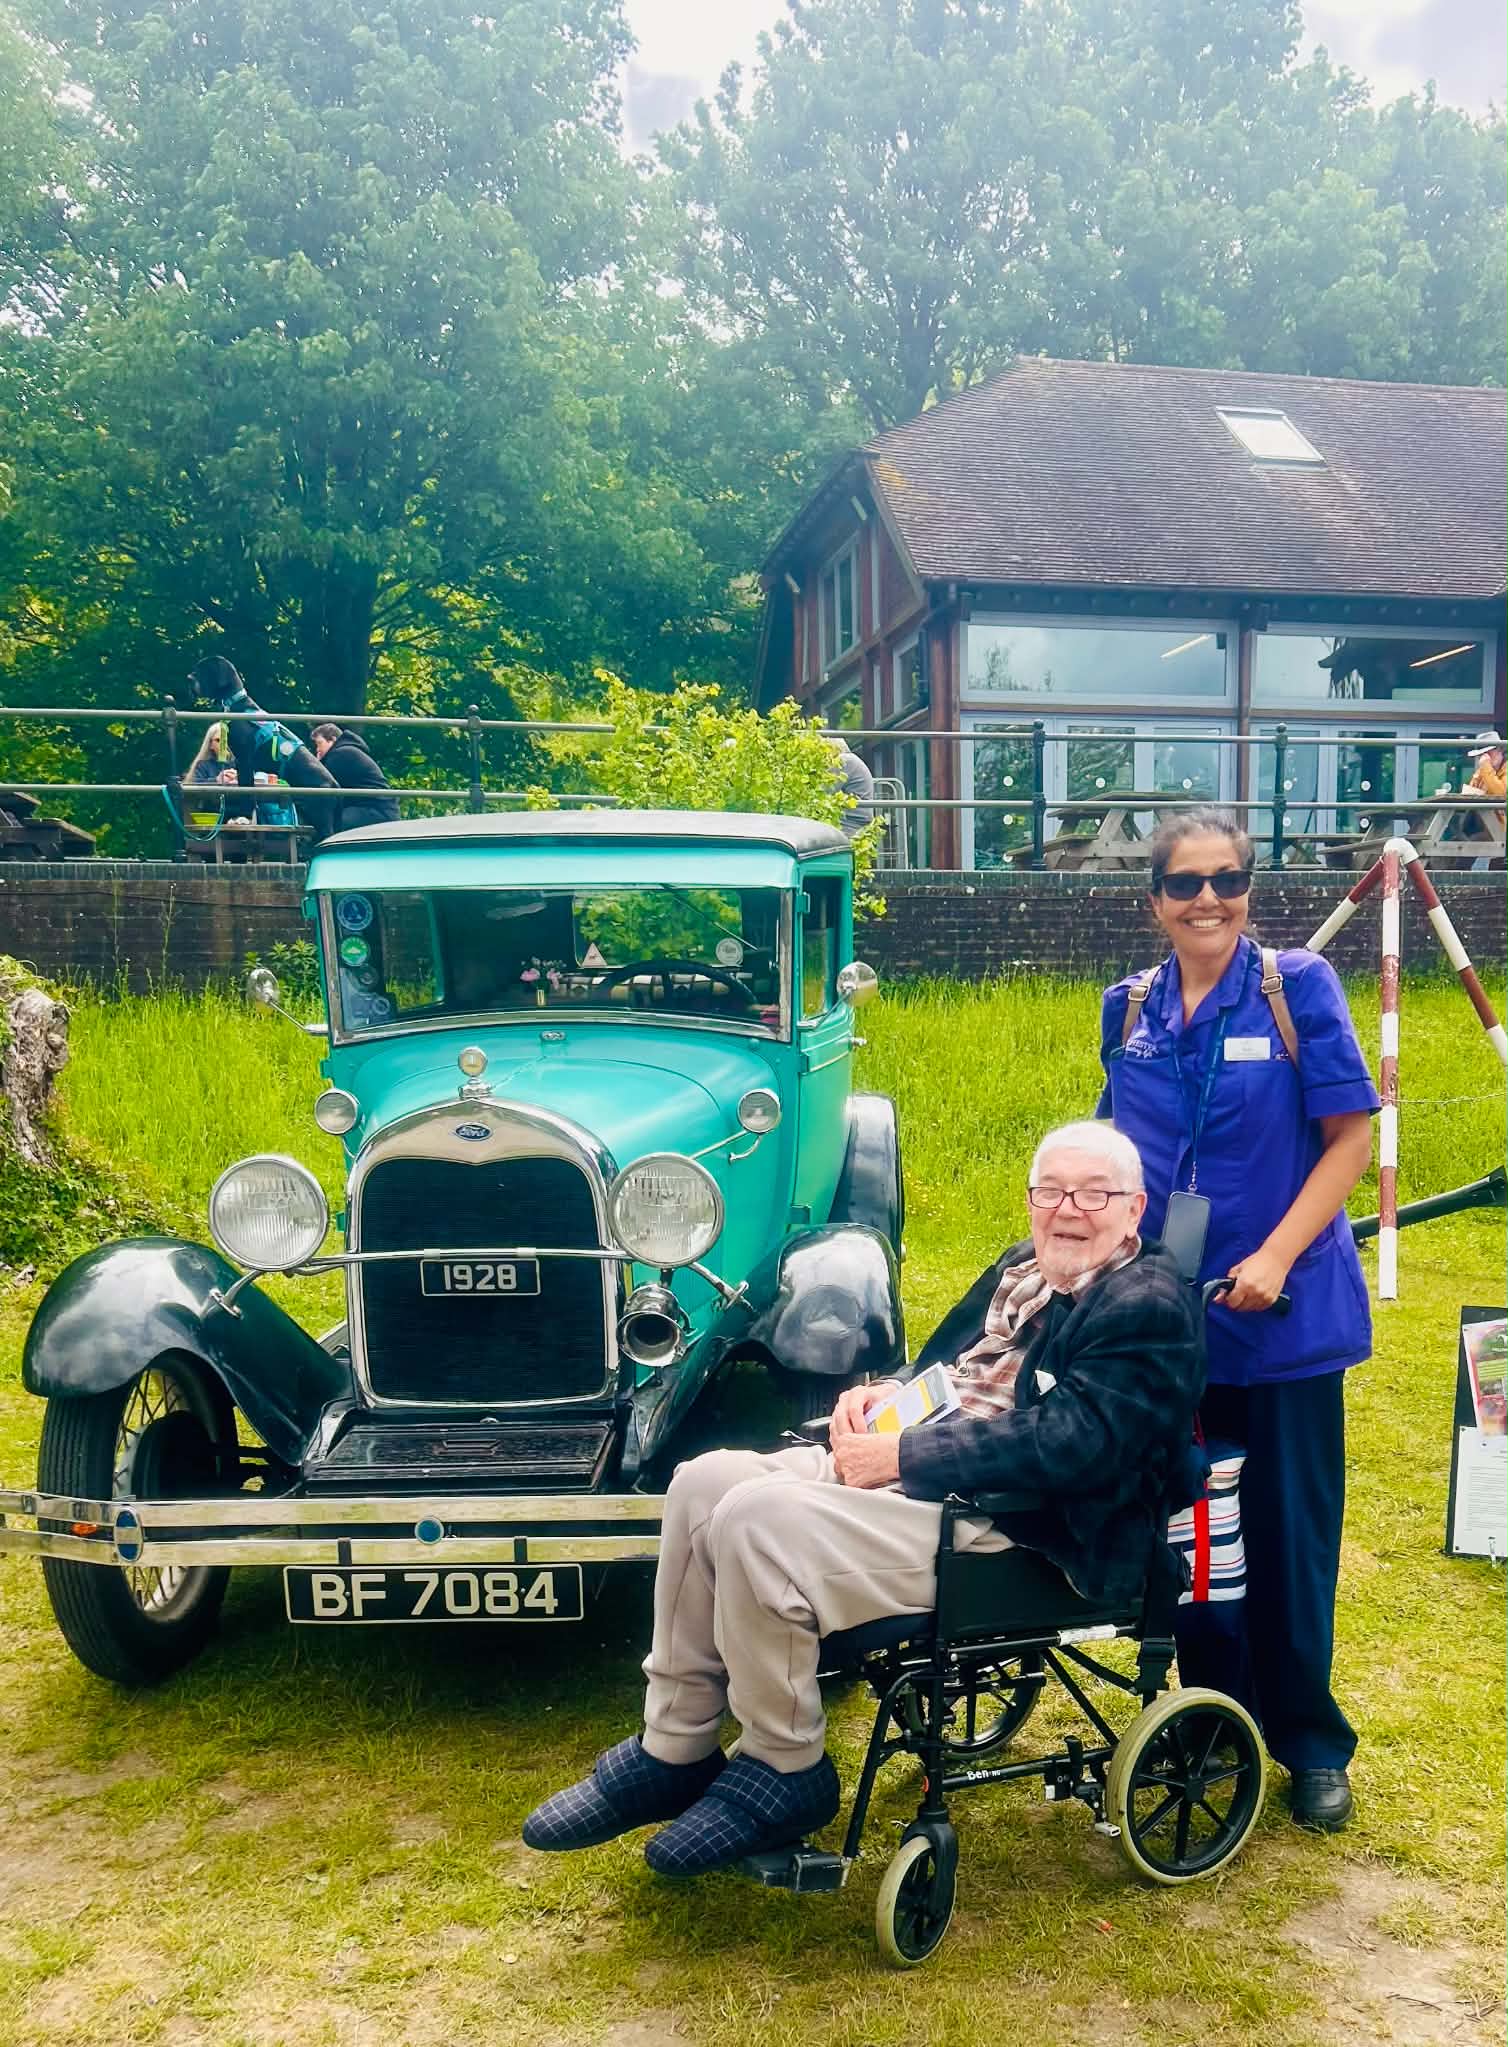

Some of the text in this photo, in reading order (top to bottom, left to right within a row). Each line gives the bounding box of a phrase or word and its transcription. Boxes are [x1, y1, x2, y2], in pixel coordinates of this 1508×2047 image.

[443, 1264, 517, 1291] 1928
[311, 1571, 559, 1617] BF 7084
